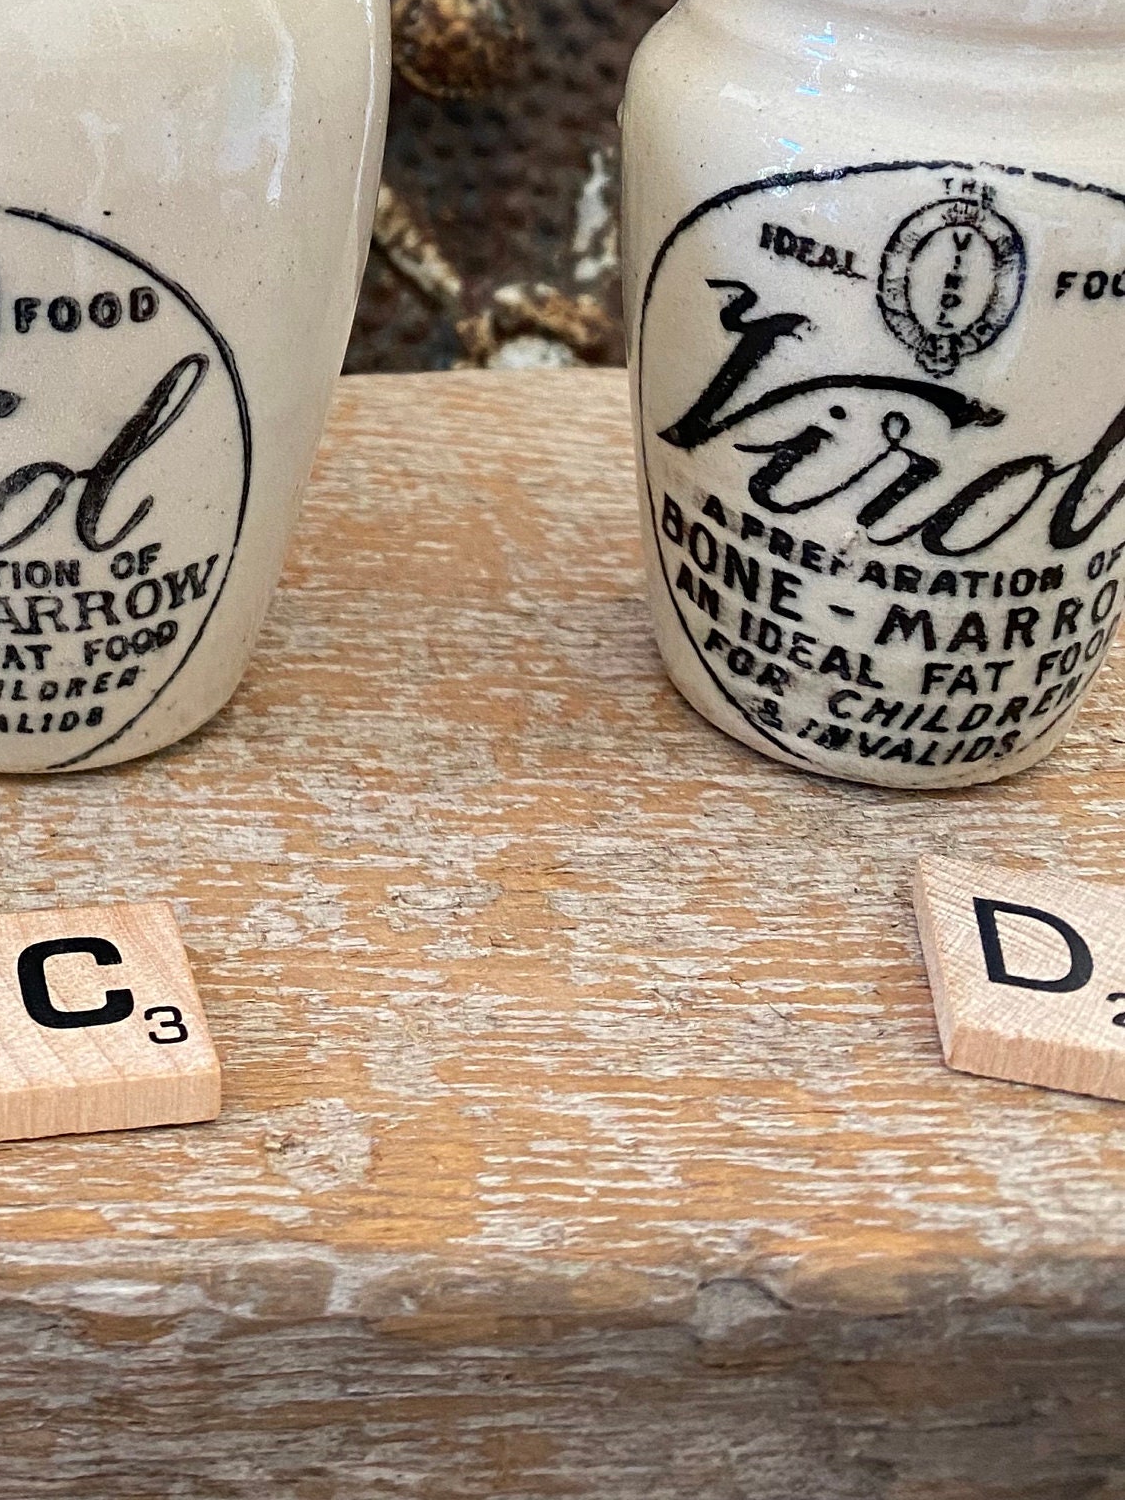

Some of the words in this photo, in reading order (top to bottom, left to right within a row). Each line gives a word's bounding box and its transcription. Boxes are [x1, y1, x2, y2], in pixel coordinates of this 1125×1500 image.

[758, 222, 867, 279] IDEAL
[14, 286, 160, 334] FOOD
[657, 279, 1125, 557] Virol
[109, 543, 164, 580] OF
[83, 620, 179, 667] FOOD
[676, 562, 719, 621] AN
[740, 607, 884, 689] IDEAL
[922, 660, 1013, 696] FAT
[828, 673, 1082, 733] CHILDREN
[797, 718, 1021, 767] INVALIDS
[973, 896, 1094, 993] D
[17, 936, 135, 1029] C
[144, 1005, 189, 1045] 3
